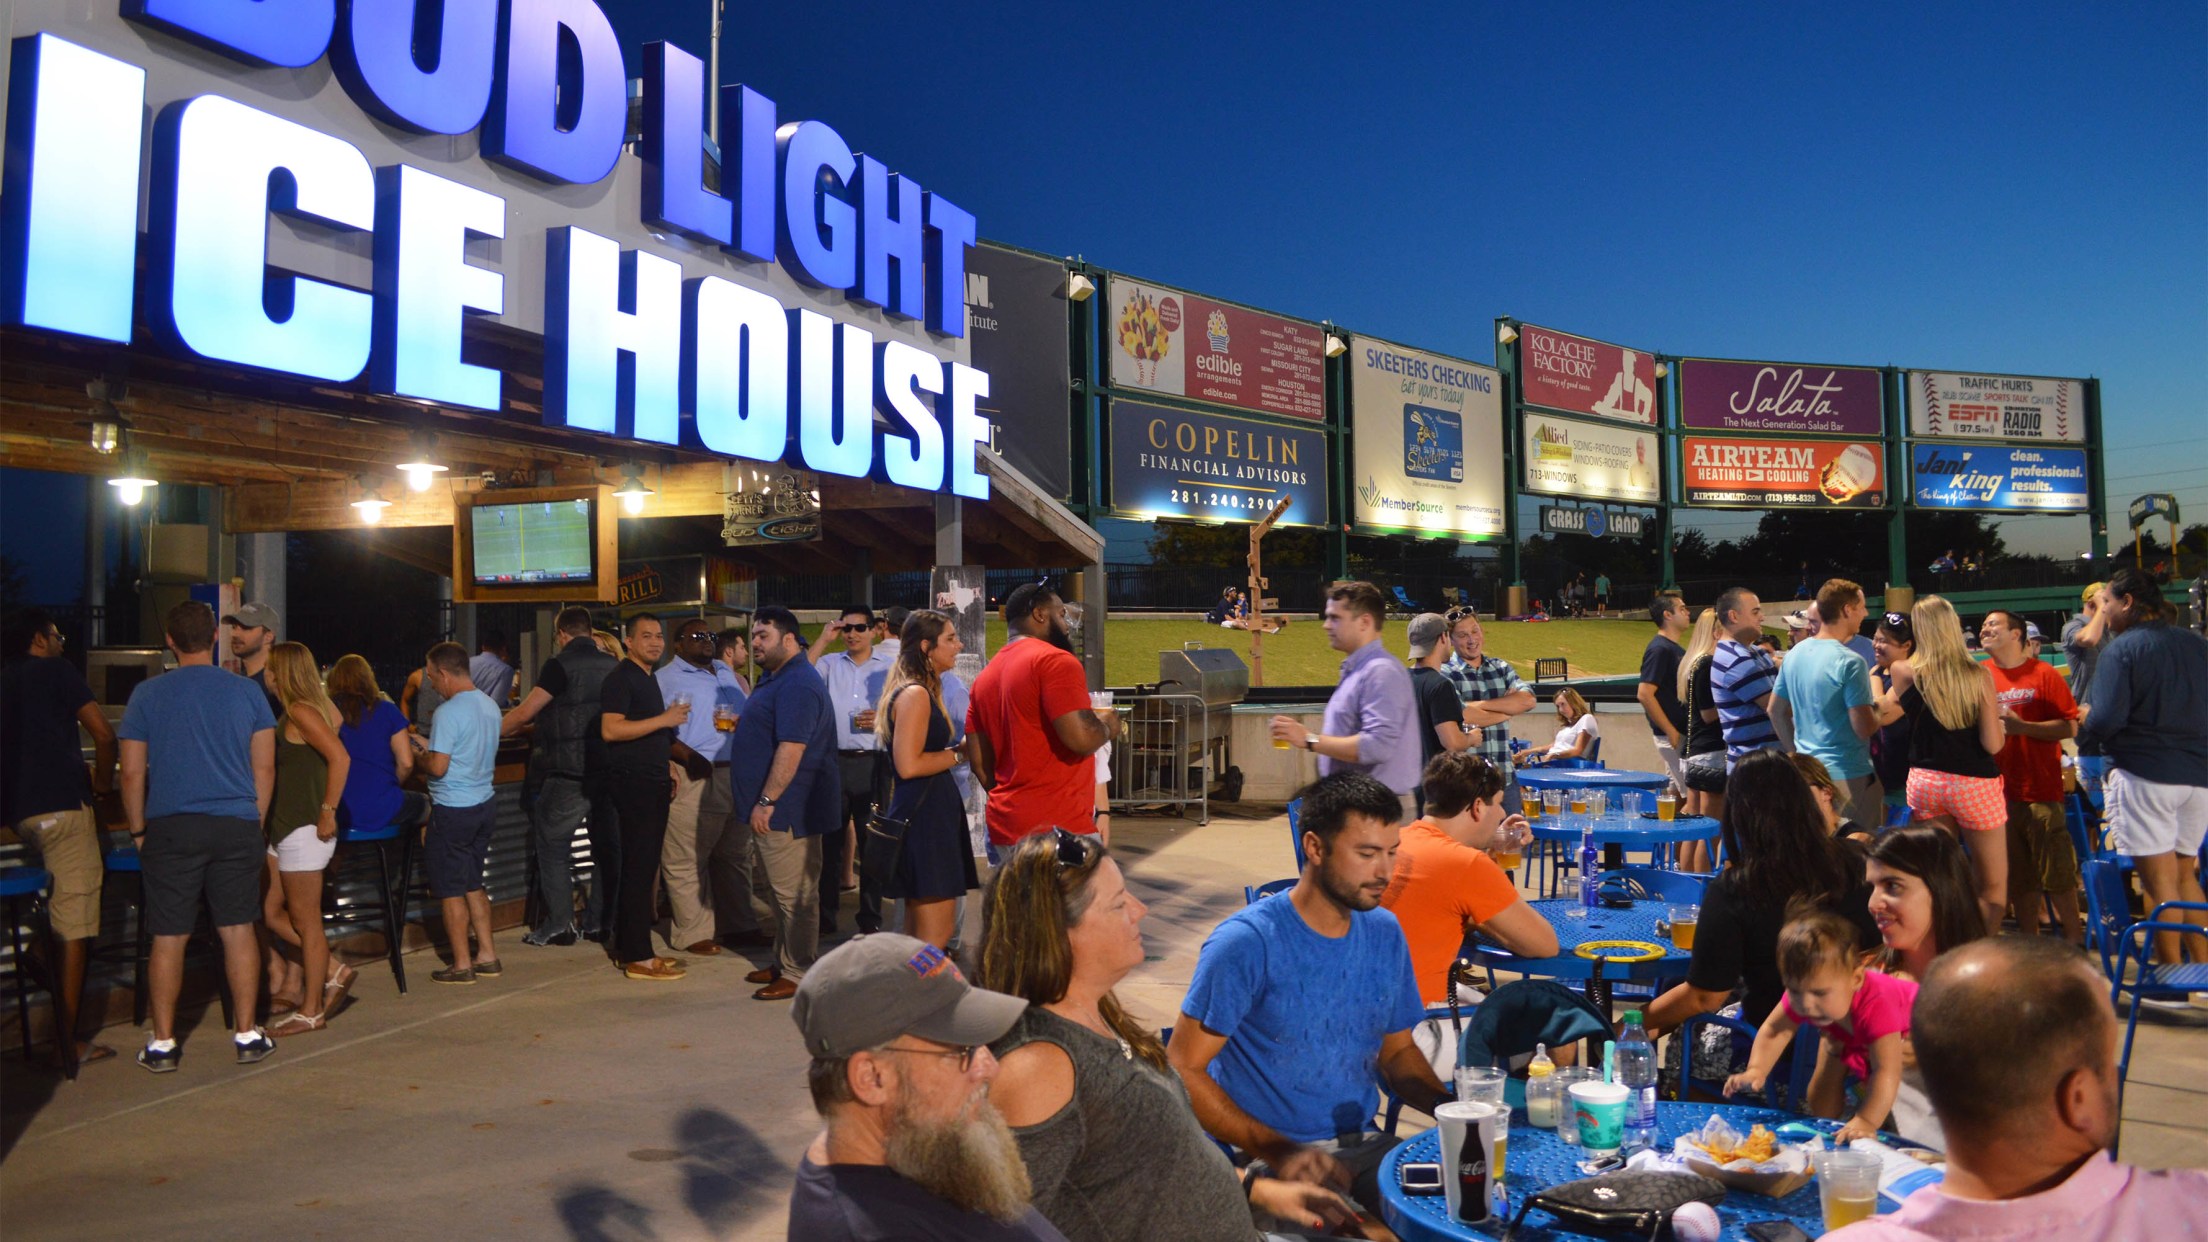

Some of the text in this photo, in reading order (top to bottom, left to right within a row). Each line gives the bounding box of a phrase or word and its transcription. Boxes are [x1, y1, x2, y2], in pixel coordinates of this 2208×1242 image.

[120, 0, 977, 339] UD LIGHT
[2, 31, 991, 500] ICE HOUSE
[1284, 325, 1298, 336] KATY
[1273, 341, 1309, 356] SUGAR LAND
[1530, 333, 1596, 363] KOLACHE
[1196, 354, 1242, 377] edible
[1271, 359, 1311, 374] MISSOURI CITY
[1366, 348, 1491, 394] SKEETERS CHECKING
[1533, 351, 1594, 379] FACTORY
[1196, 371, 1242, 386] arrangements
[1278, 378, 1305, 391] HOUSTON
[1542, 374, 1560, 389] history
[1560, 379, 1567, 389] of
[1567, 381, 1577, 390] good
[1959, 377, 2033, 393] TRAFFIC HURTS
[1203, 388, 1237, 401] edible.com
[1401, 378, 1416, 393] Get
[1418, 383, 1438, 404] yours
[1730, 367, 1843, 418] Salata
[1984, 393, 2010, 403] SPORTS
[2012, 394, 2029, 403] TALK
[1948, 403, 1999, 422] ESPN
[2003, 412, 2041, 430] RADIO
[1723, 416, 1844, 431] The Next Generation Salad Bar
[1148, 418, 1298, 466] COPELIN
[1542, 425, 1568, 445] Allied
[1610, 445, 1632, 458] COVERS
[1691, 444, 1815, 470] AIRTEAM
[2010, 449, 2044, 462] clean.
[1140, 453, 1307, 486] FINANCIAL ADVISORS
[1916, 451, 1972, 475] Jani
[1530, 469, 1577, 484] 713-WINDOWS
[1698, 467, 1809, 483] HEATING COOLING
[2010, 465, 2083, 479] professional.
[2011, 480, 2053, 492] results.
[1381, 496, 1443, 514] MemberSource
[1693, 492, 1762, 502] AIRTEAMLTD.COM
[1765, 493, 1783, 503] (713)
[1918, 488, 1932, 499] The
[1932, 489, 1950, 505] King
[1950, 490, 1958, 505] of
[770, 524, 817, 535] LIGHT
[1548, 508, 1640, 534] GRASS LAND
[1591, 859, 1599, 892] ULTRA
